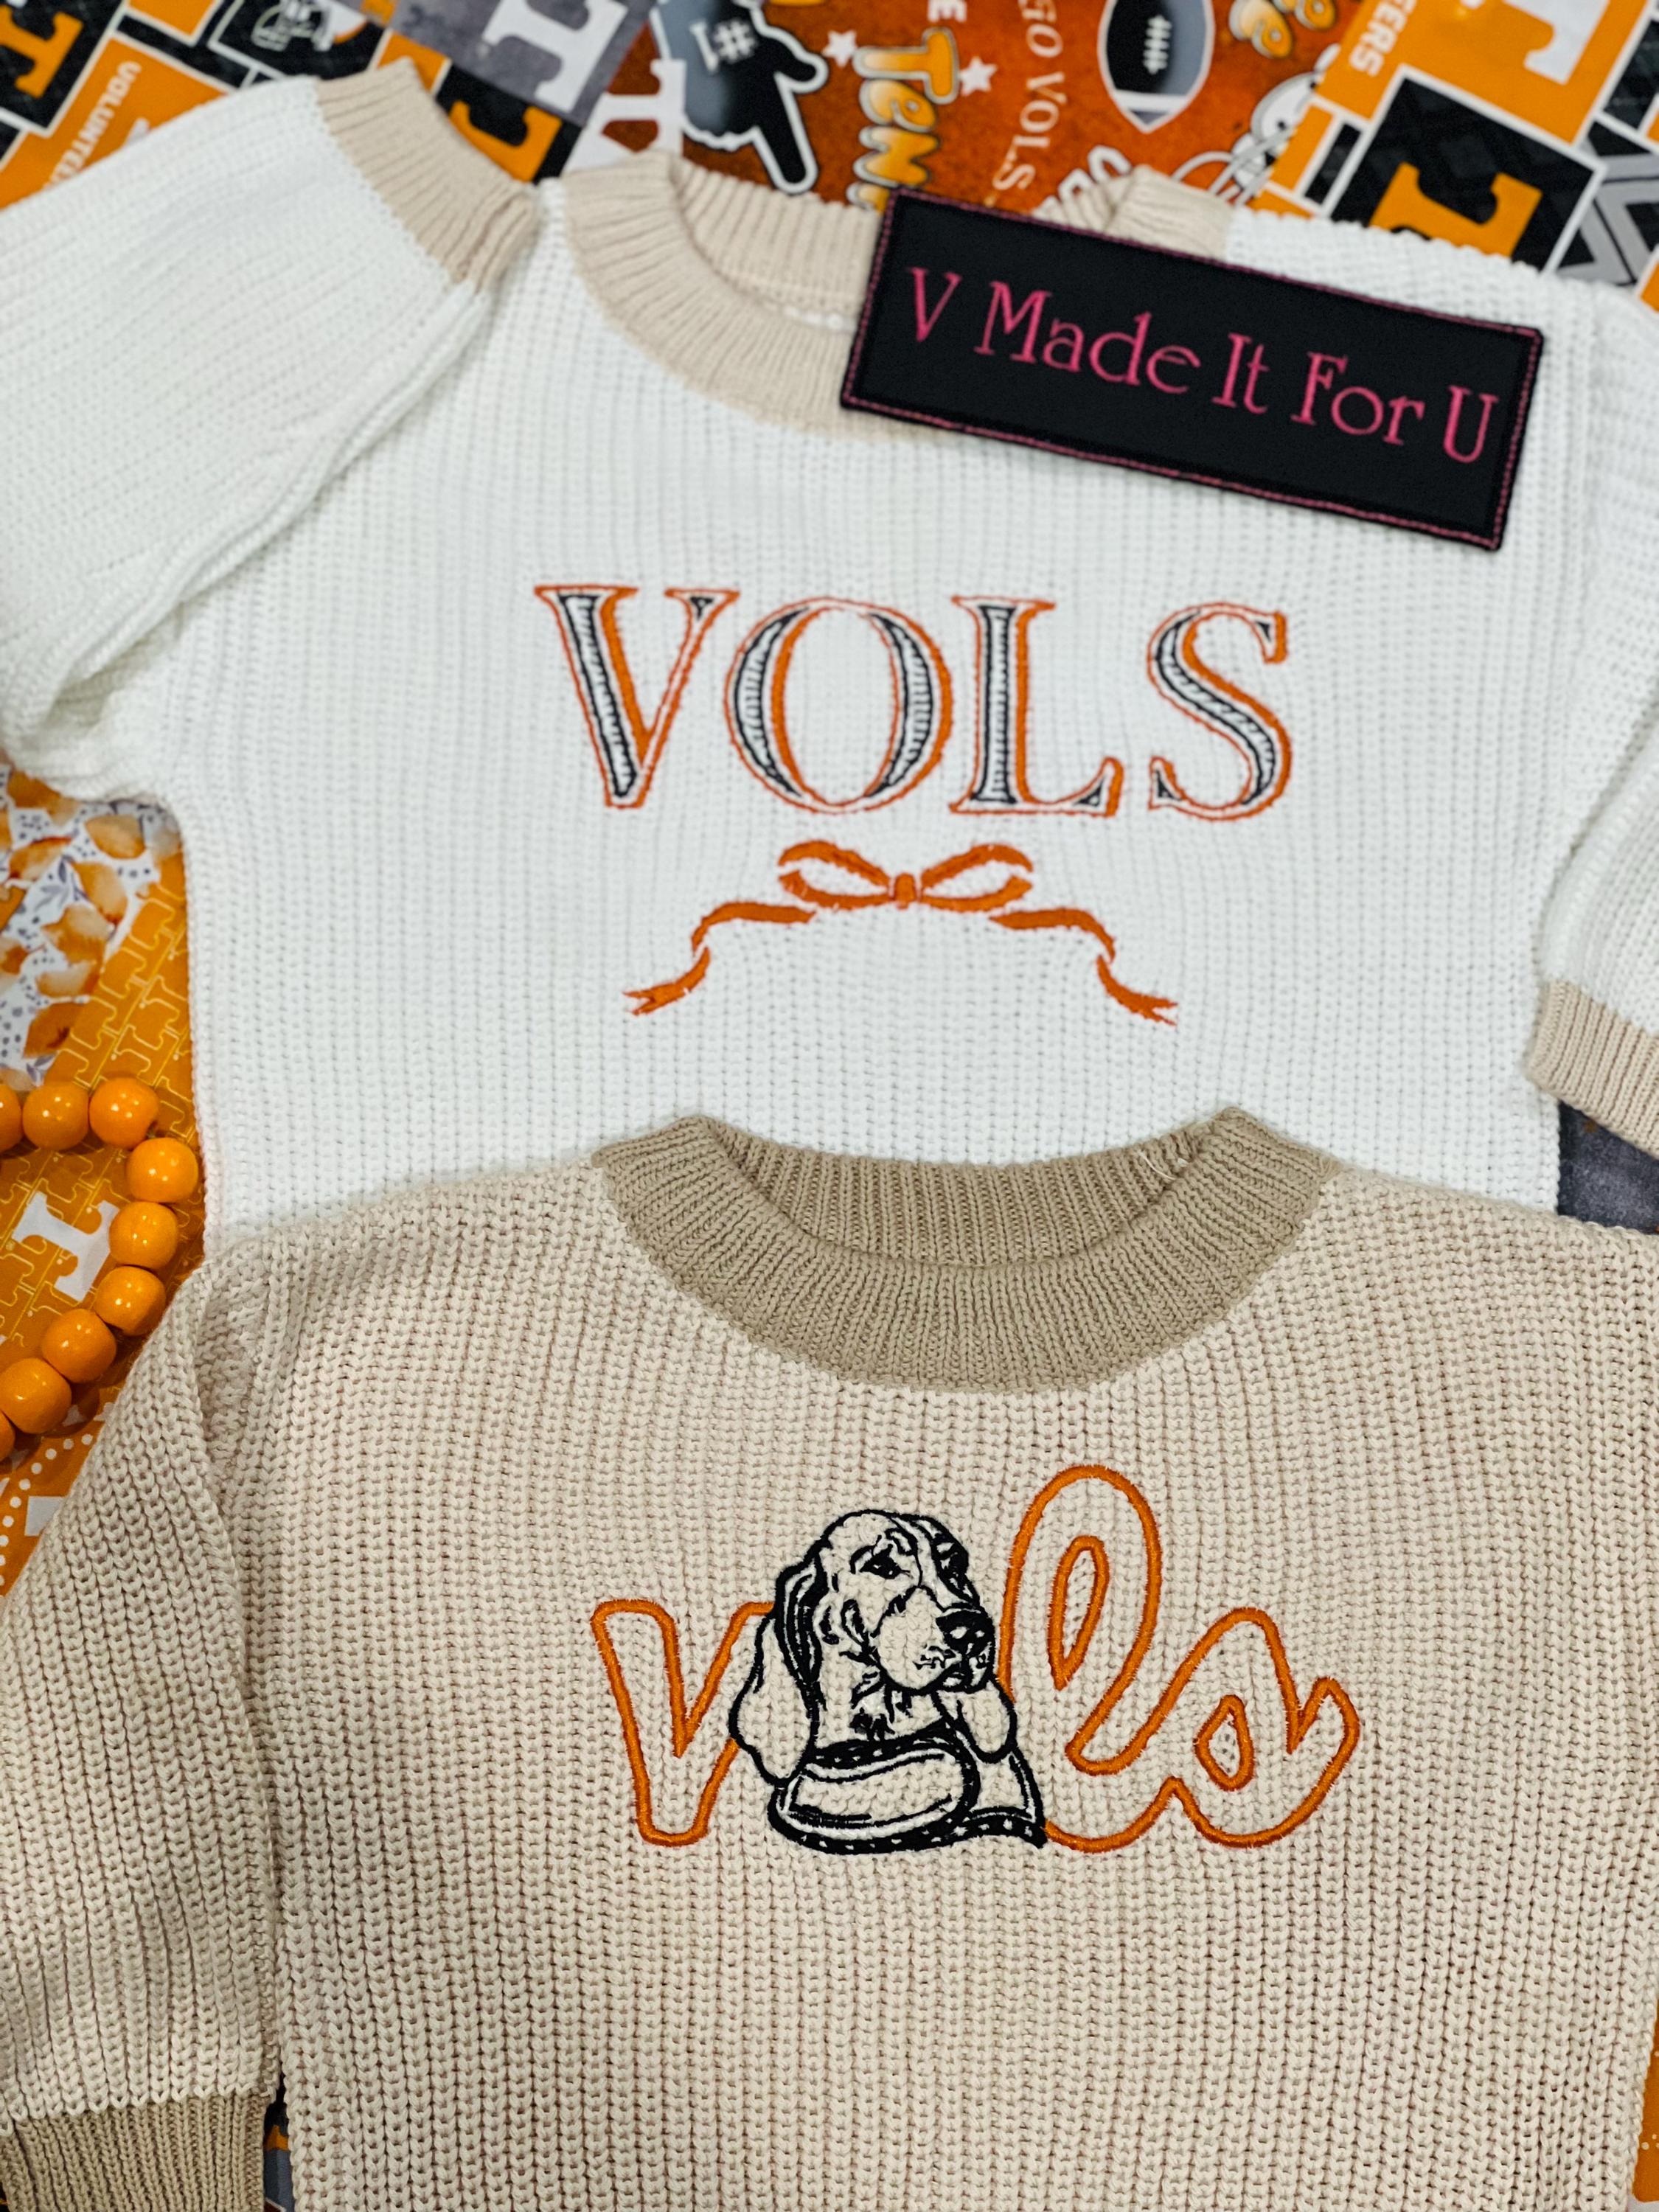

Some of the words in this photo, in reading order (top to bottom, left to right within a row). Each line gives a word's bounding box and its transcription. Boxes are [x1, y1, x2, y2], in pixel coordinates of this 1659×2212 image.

[908, 267, 962, 342] V
[973, 280, 1201, 394] Made
[1211, 333, 1271, 414] It
[1290, 350, 1425, 445] For
[1443, 384, 1500, 465] U
[534, 584, 1293, 821] VOLS
